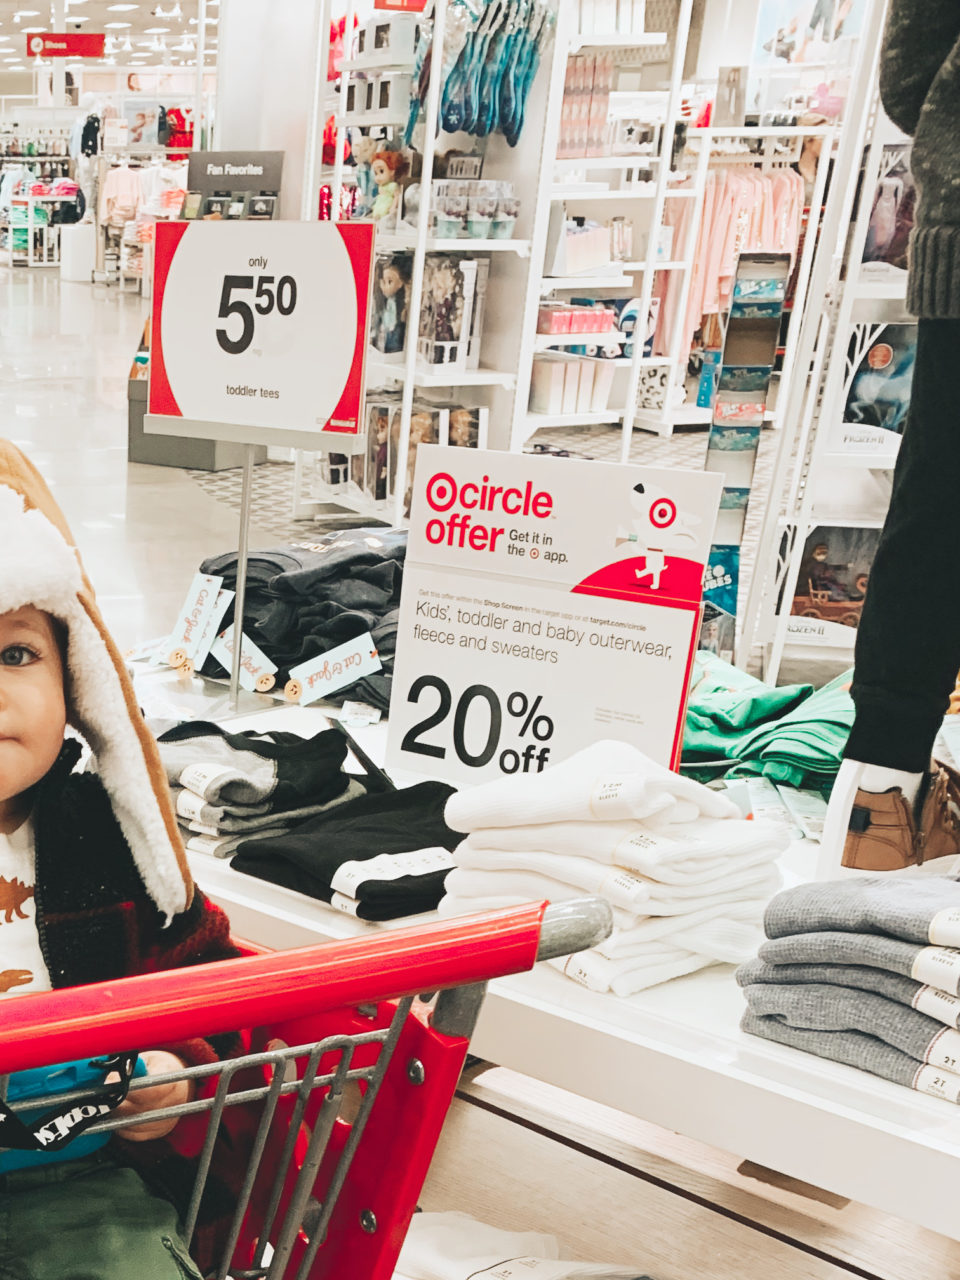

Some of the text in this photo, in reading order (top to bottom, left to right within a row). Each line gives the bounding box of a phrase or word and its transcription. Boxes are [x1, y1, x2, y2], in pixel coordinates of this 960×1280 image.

[224, 163, 264, 176] Favorites
[248, 256, 268, 269] only
[226, 384, 280, 399] toddler tees
[459, 474, 553, 519] circle
[425, 513, 505, 552] offer
[509, 529, 553, 545] Get it in
[507, 544, 569, 565] the app.
[484, 599, 501, 609] Shop
[501, 602, 524, 611] Screen
[457, 608, 508, 630] toddler
[512, 620, 542, 636] and
[546, 622, 585, 646] baby
[589, 632, 672, 661] outerwear,
[787, 624, 816, 634] ROZEN
[413, 623, 558, 664] fleece and sweaters
[345, 652, 362, 668] Cat
[305, 660, 332, 688] Jack
[498, 745, 551, 775] off
[944, 1055, 957, 1067] 2T
[933, 1077, 947, 1088] 2T
